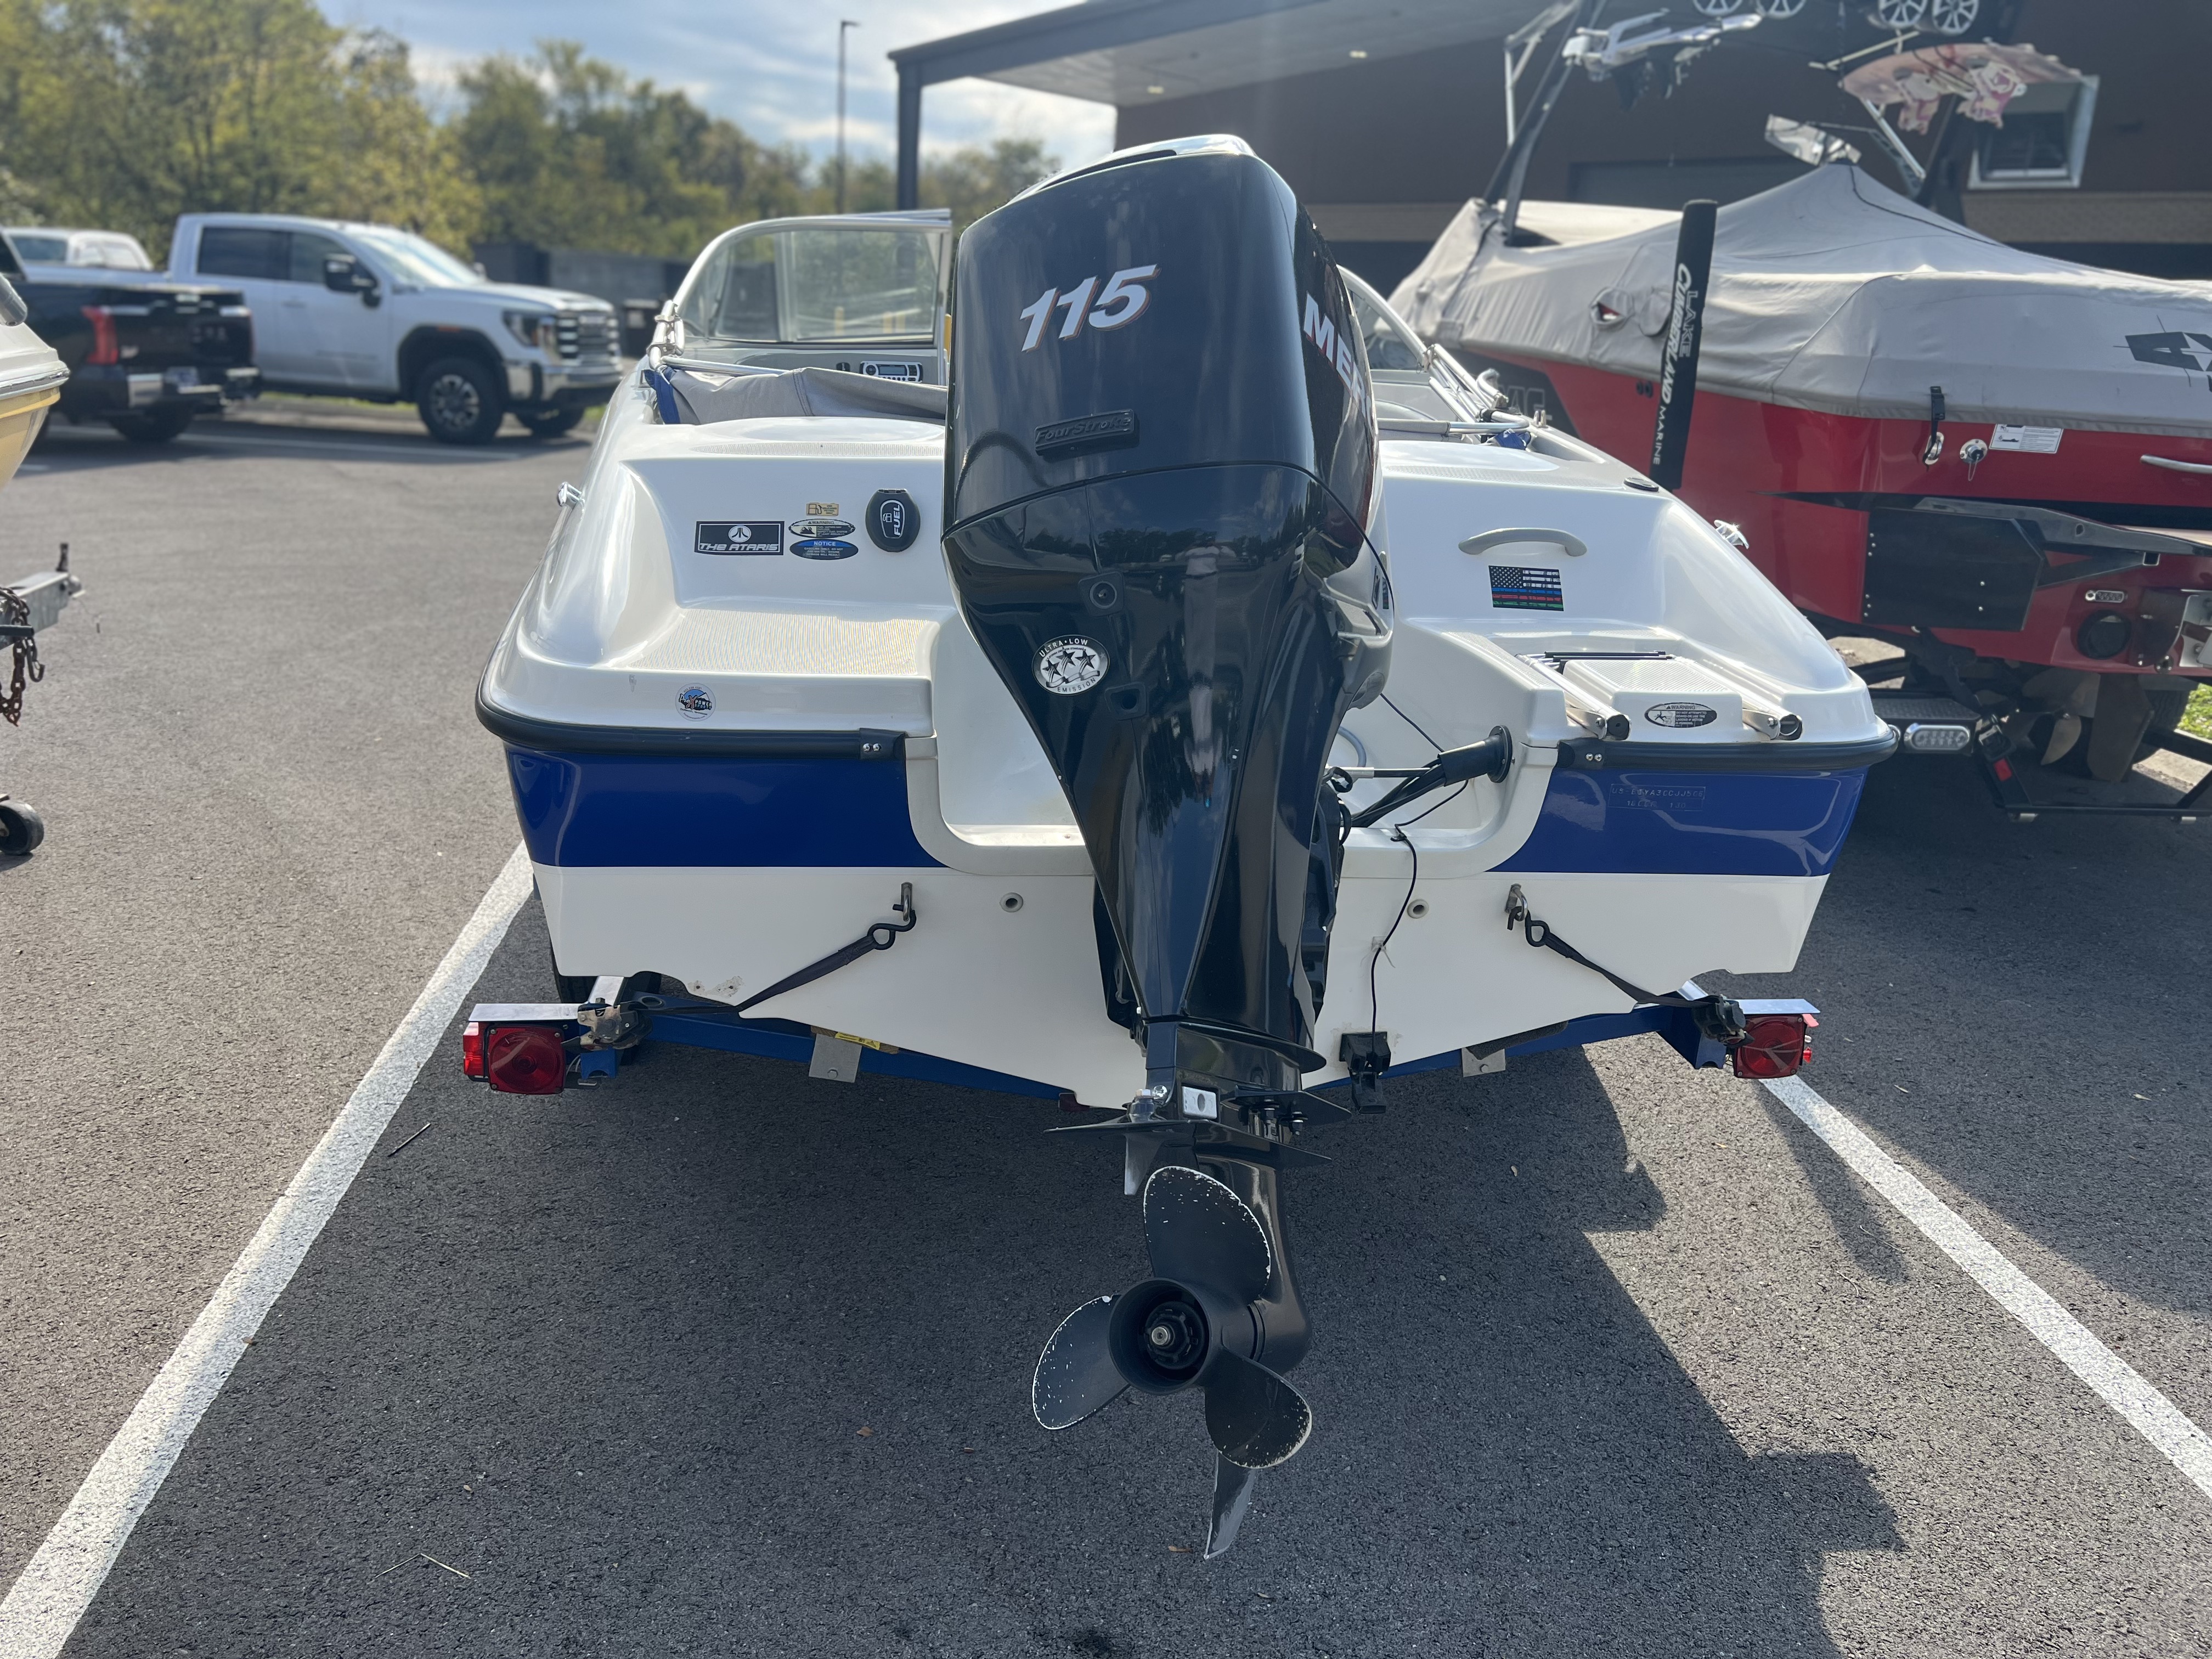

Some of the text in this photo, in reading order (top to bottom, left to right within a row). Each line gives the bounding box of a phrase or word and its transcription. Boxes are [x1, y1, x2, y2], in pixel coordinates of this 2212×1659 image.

[1019, 264, 1161, 353] 115
[1661, 263, 1692, 404] CUMBERLAND
[1679, 290, 1699, 358] LAKE
[1035, 416, 1132, 444] FourStroke
[1653, 405, 1667, 465] MARINE
[1039, 640, 1063, 658] ULTRA
[1057, 677, 1096, 692] EMISSION
